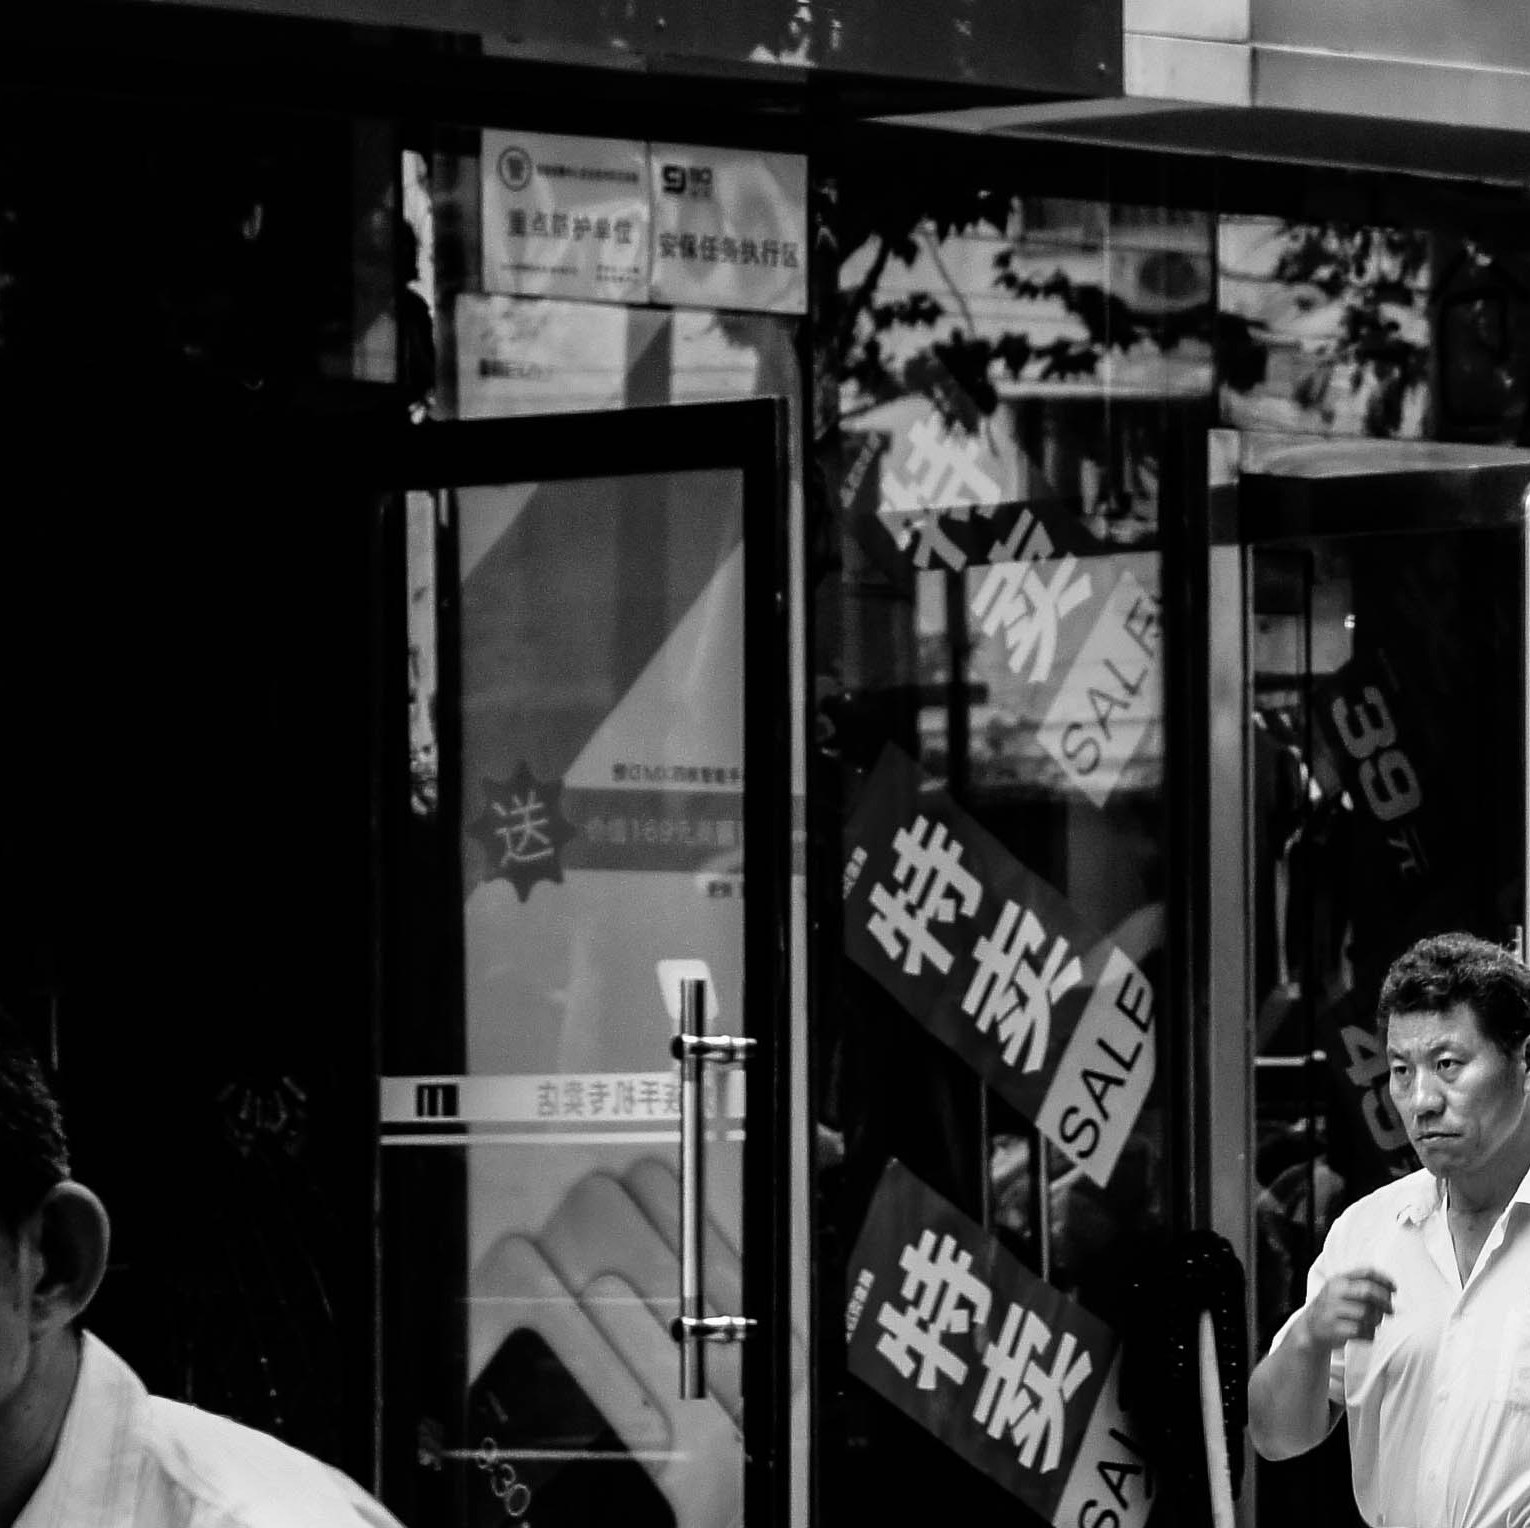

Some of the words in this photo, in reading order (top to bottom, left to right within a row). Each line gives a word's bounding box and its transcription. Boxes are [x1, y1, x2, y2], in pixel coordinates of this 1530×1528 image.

[508, 209, 634, 244] 重点防护单位
[493, 795, 556, 868] 送
[866, 814, 1085, 1074] 特卖
[1058, 970, 1152, 1161] SALE
[874, 1229, 1094, 1475] 特卖
